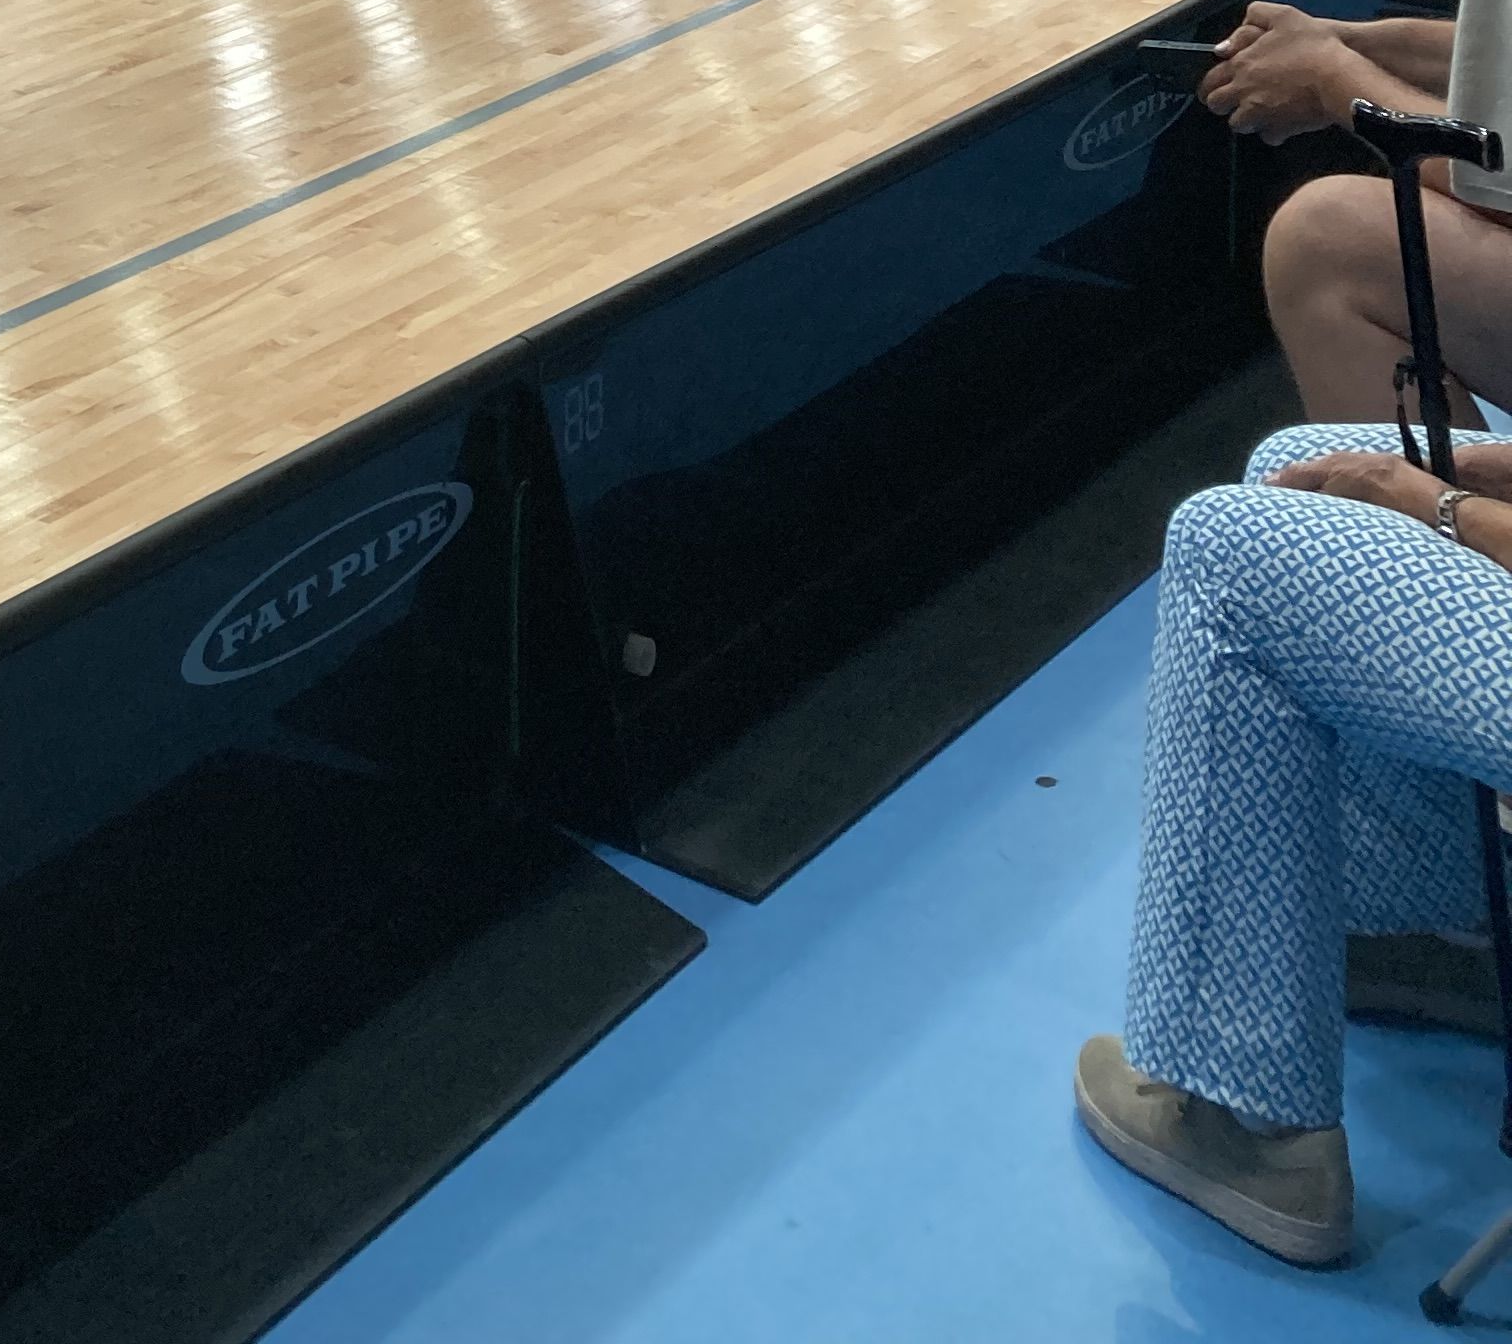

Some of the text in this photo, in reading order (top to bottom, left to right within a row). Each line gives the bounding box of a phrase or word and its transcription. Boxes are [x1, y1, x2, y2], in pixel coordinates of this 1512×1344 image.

[1080, 110, 1128, 155] FAT
[214, 497, 451, 664] FAT PIPE
